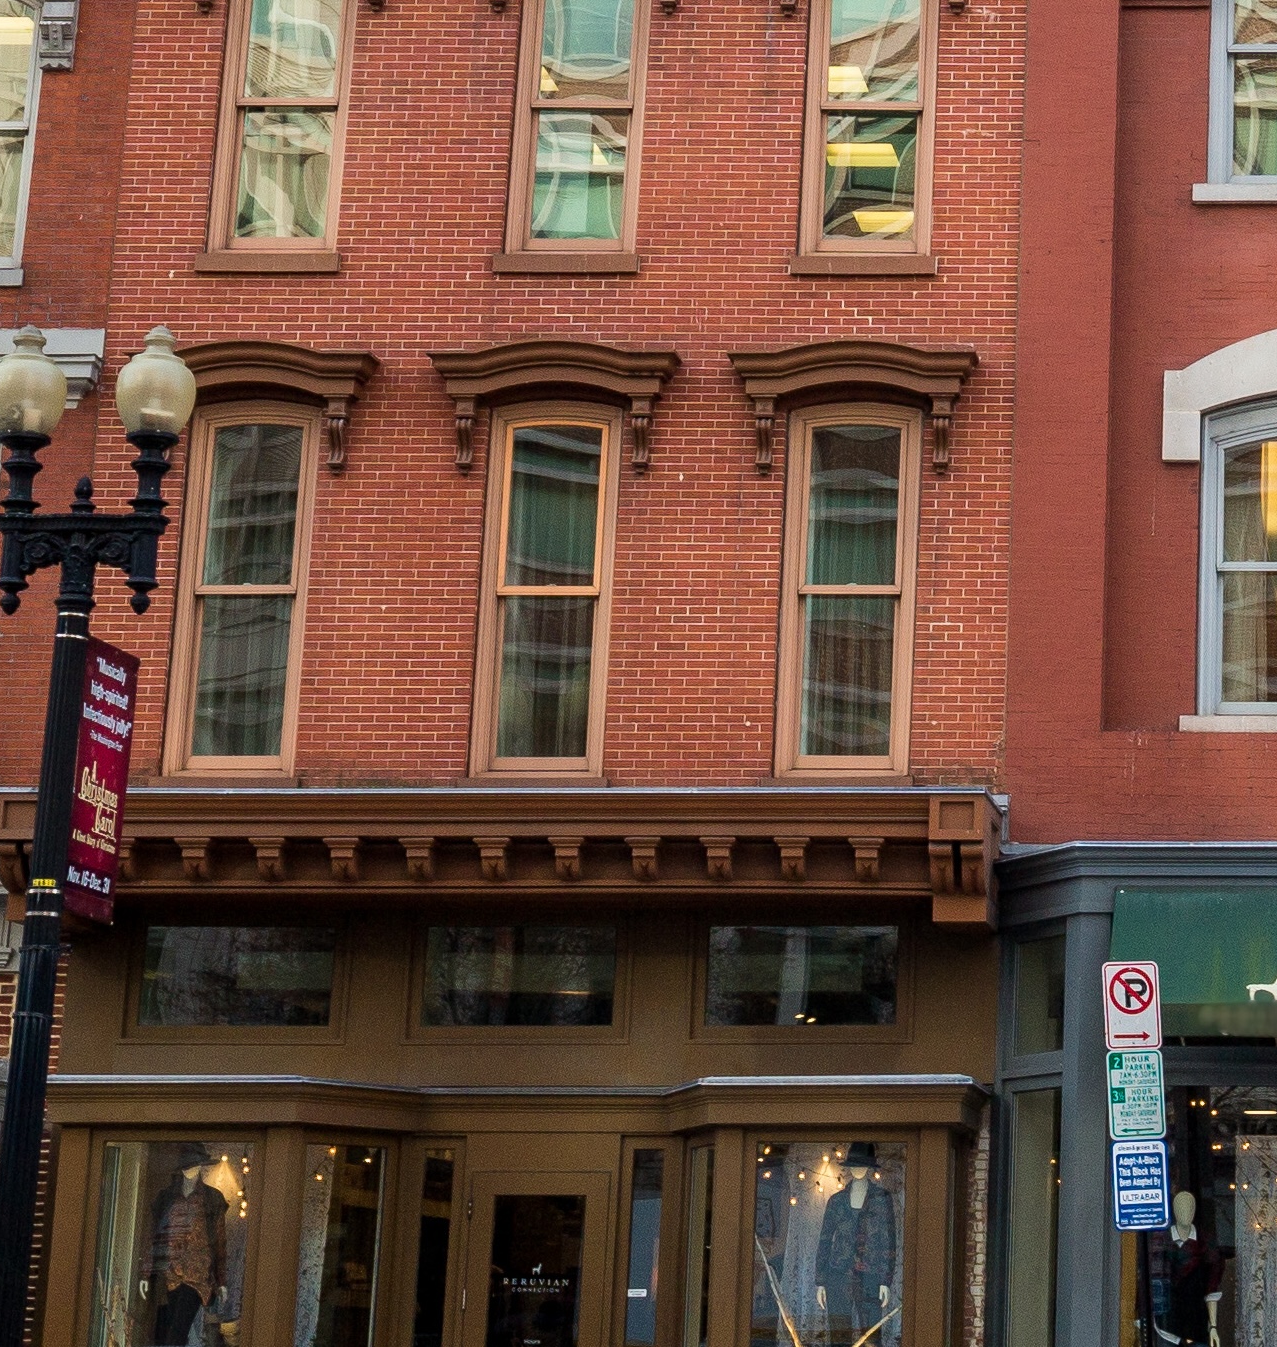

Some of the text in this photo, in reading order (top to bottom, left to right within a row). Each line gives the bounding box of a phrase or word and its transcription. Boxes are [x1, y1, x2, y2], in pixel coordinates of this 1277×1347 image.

[1114, 1057, 1120, 1068] 2
[1125, 1063, 1156, 1071] PARKING
[1119, 1156, 1159, 1166] Adopt-A-Block
[1119, 1166, 1161, 1176] This Block Has
[1122, 1193, 1160, 1202] ULTRABAR
[503, 1277, 570, 1286] PERUVIAN
